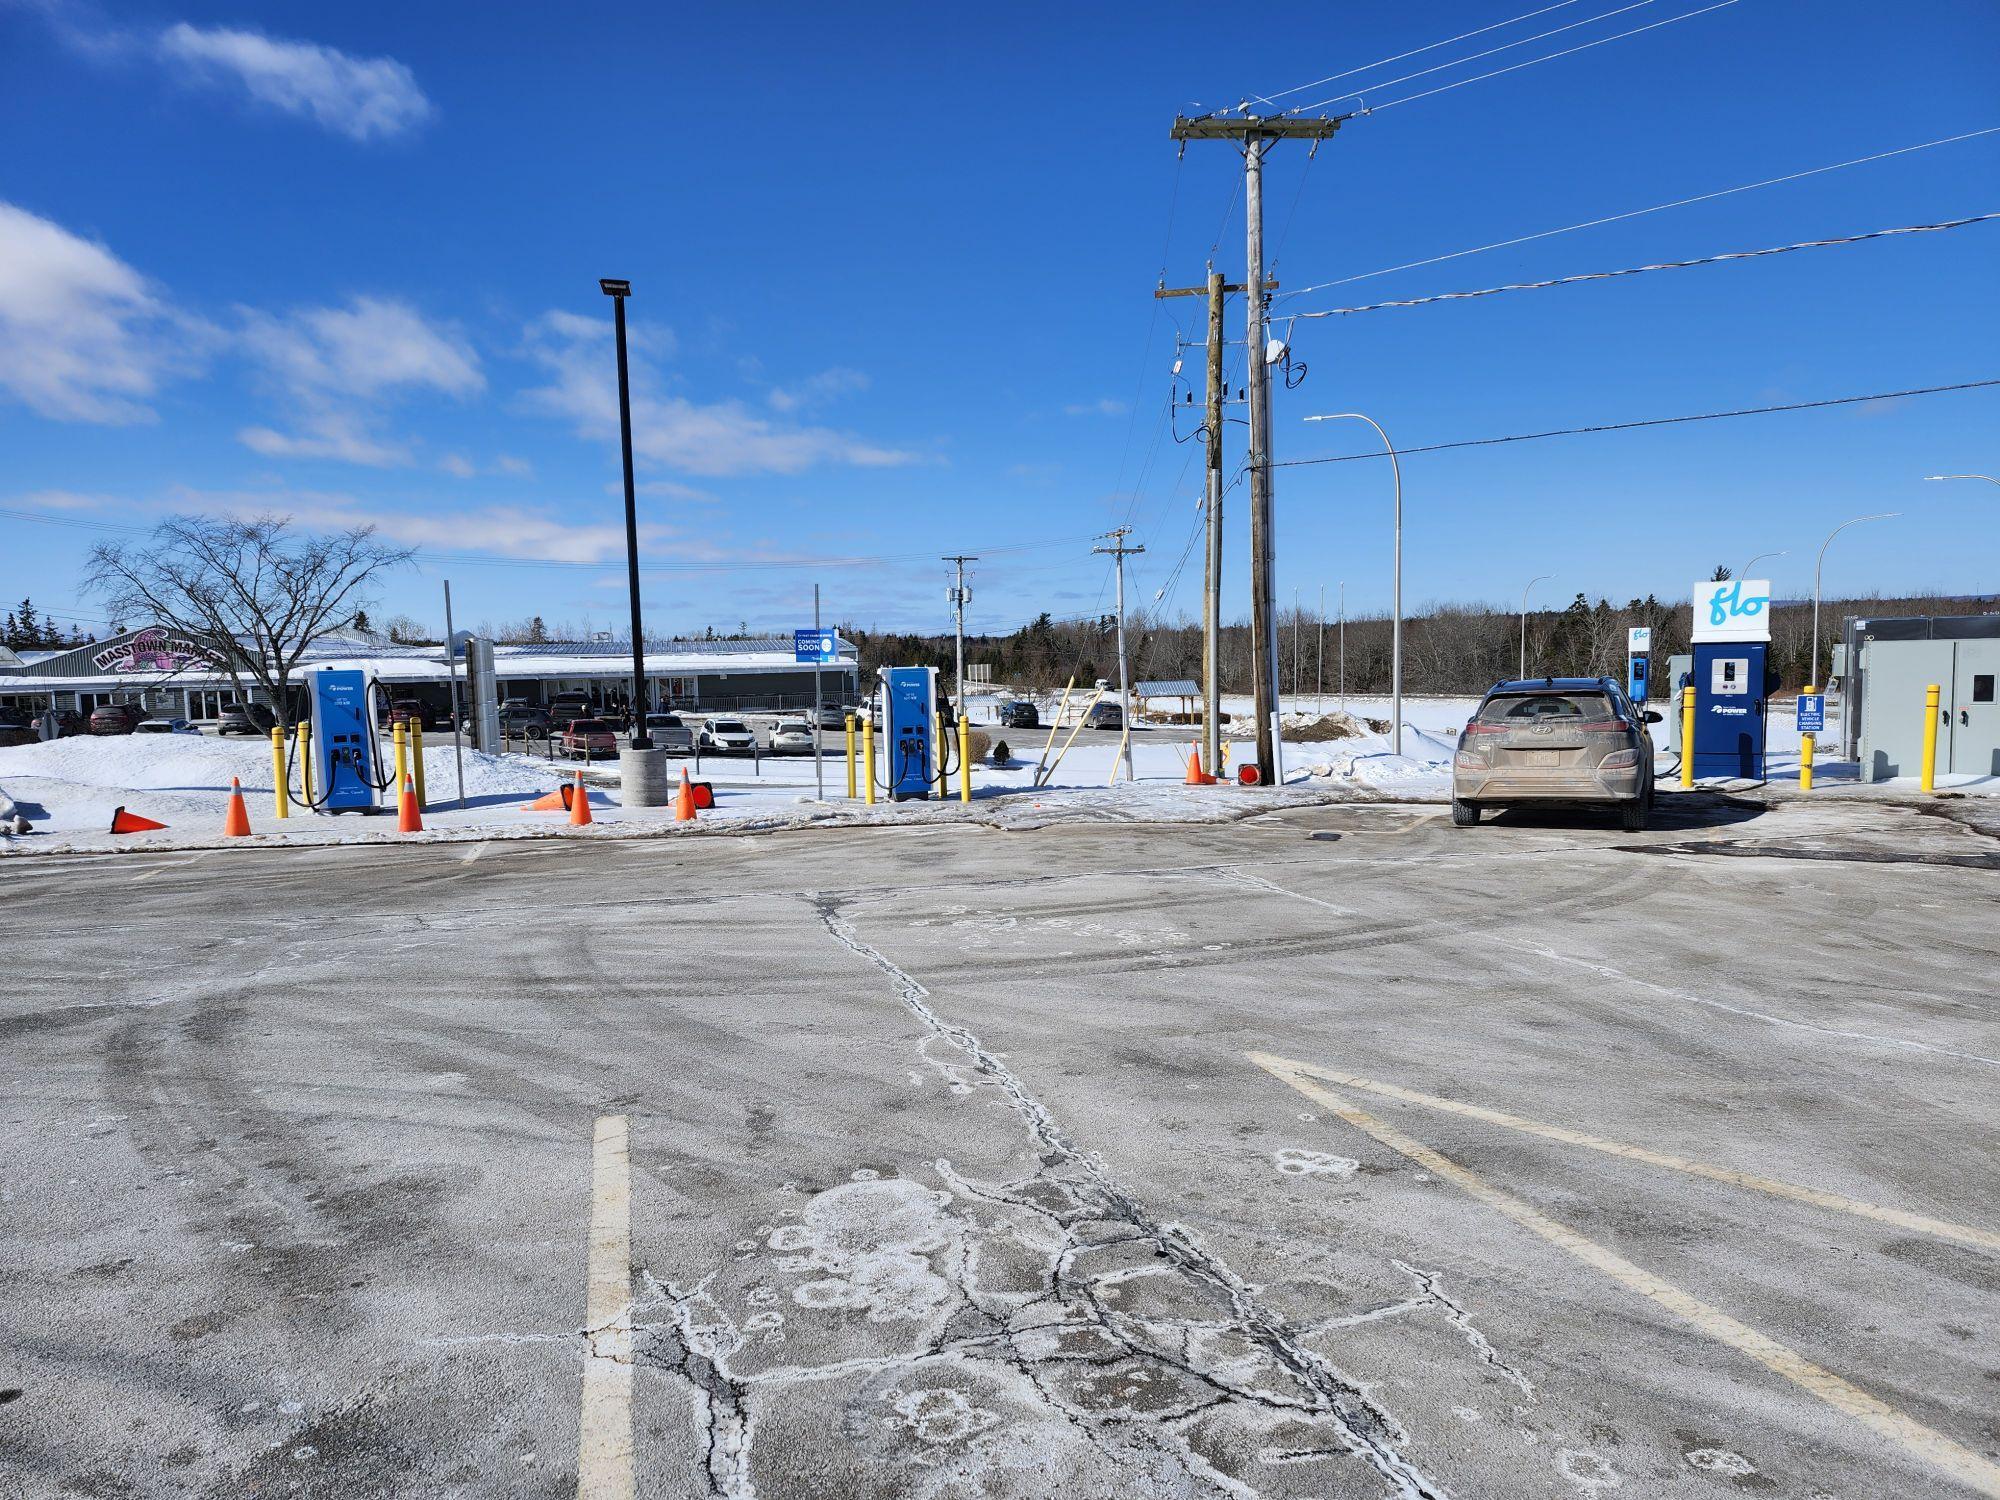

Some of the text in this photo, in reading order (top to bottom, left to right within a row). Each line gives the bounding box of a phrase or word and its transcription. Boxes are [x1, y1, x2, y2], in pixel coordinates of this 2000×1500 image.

[1709, 580, 1769, 625] flo
[1634, 629, 1649, 640] flo
[95, 640, 167, 668] MASSTOWN
